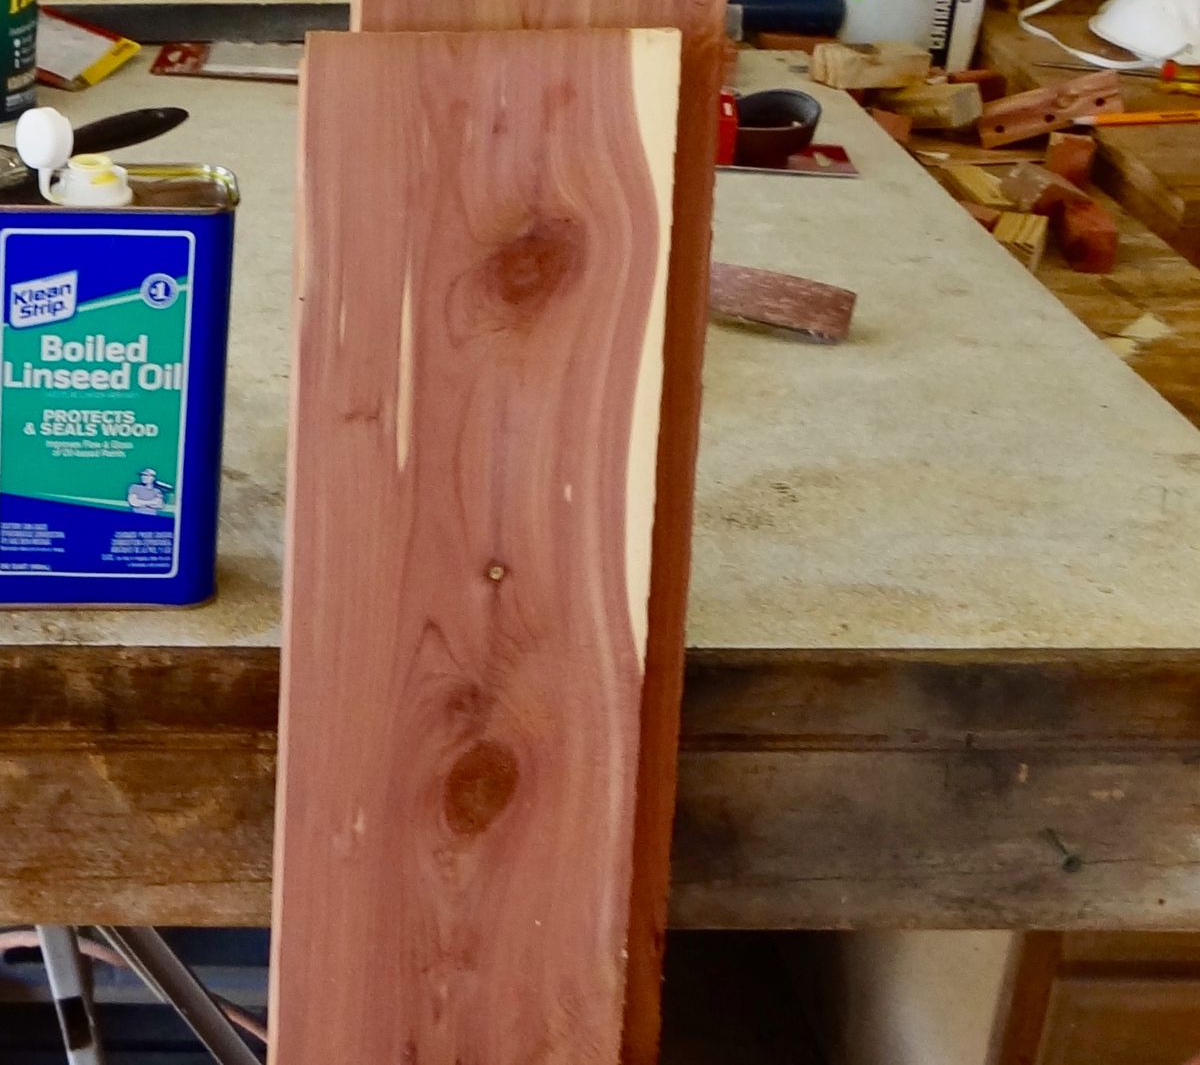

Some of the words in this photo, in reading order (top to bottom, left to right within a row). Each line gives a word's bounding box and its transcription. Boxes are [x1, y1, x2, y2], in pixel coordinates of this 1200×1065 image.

[14, 284, 71, 306] Klean
[20, 300, 58, 319] Strip
[40, 334, 148, 363] Boiled
[2, 361, 131, 390] Linseed
[137, 363, 184, 391] Oil
[42, 409, 136, 424] PROTECTS
[23, 422, 37, 436] &
[40, 422, 98, 437] SEALS
[102, 423, 159, 437] WOOD
